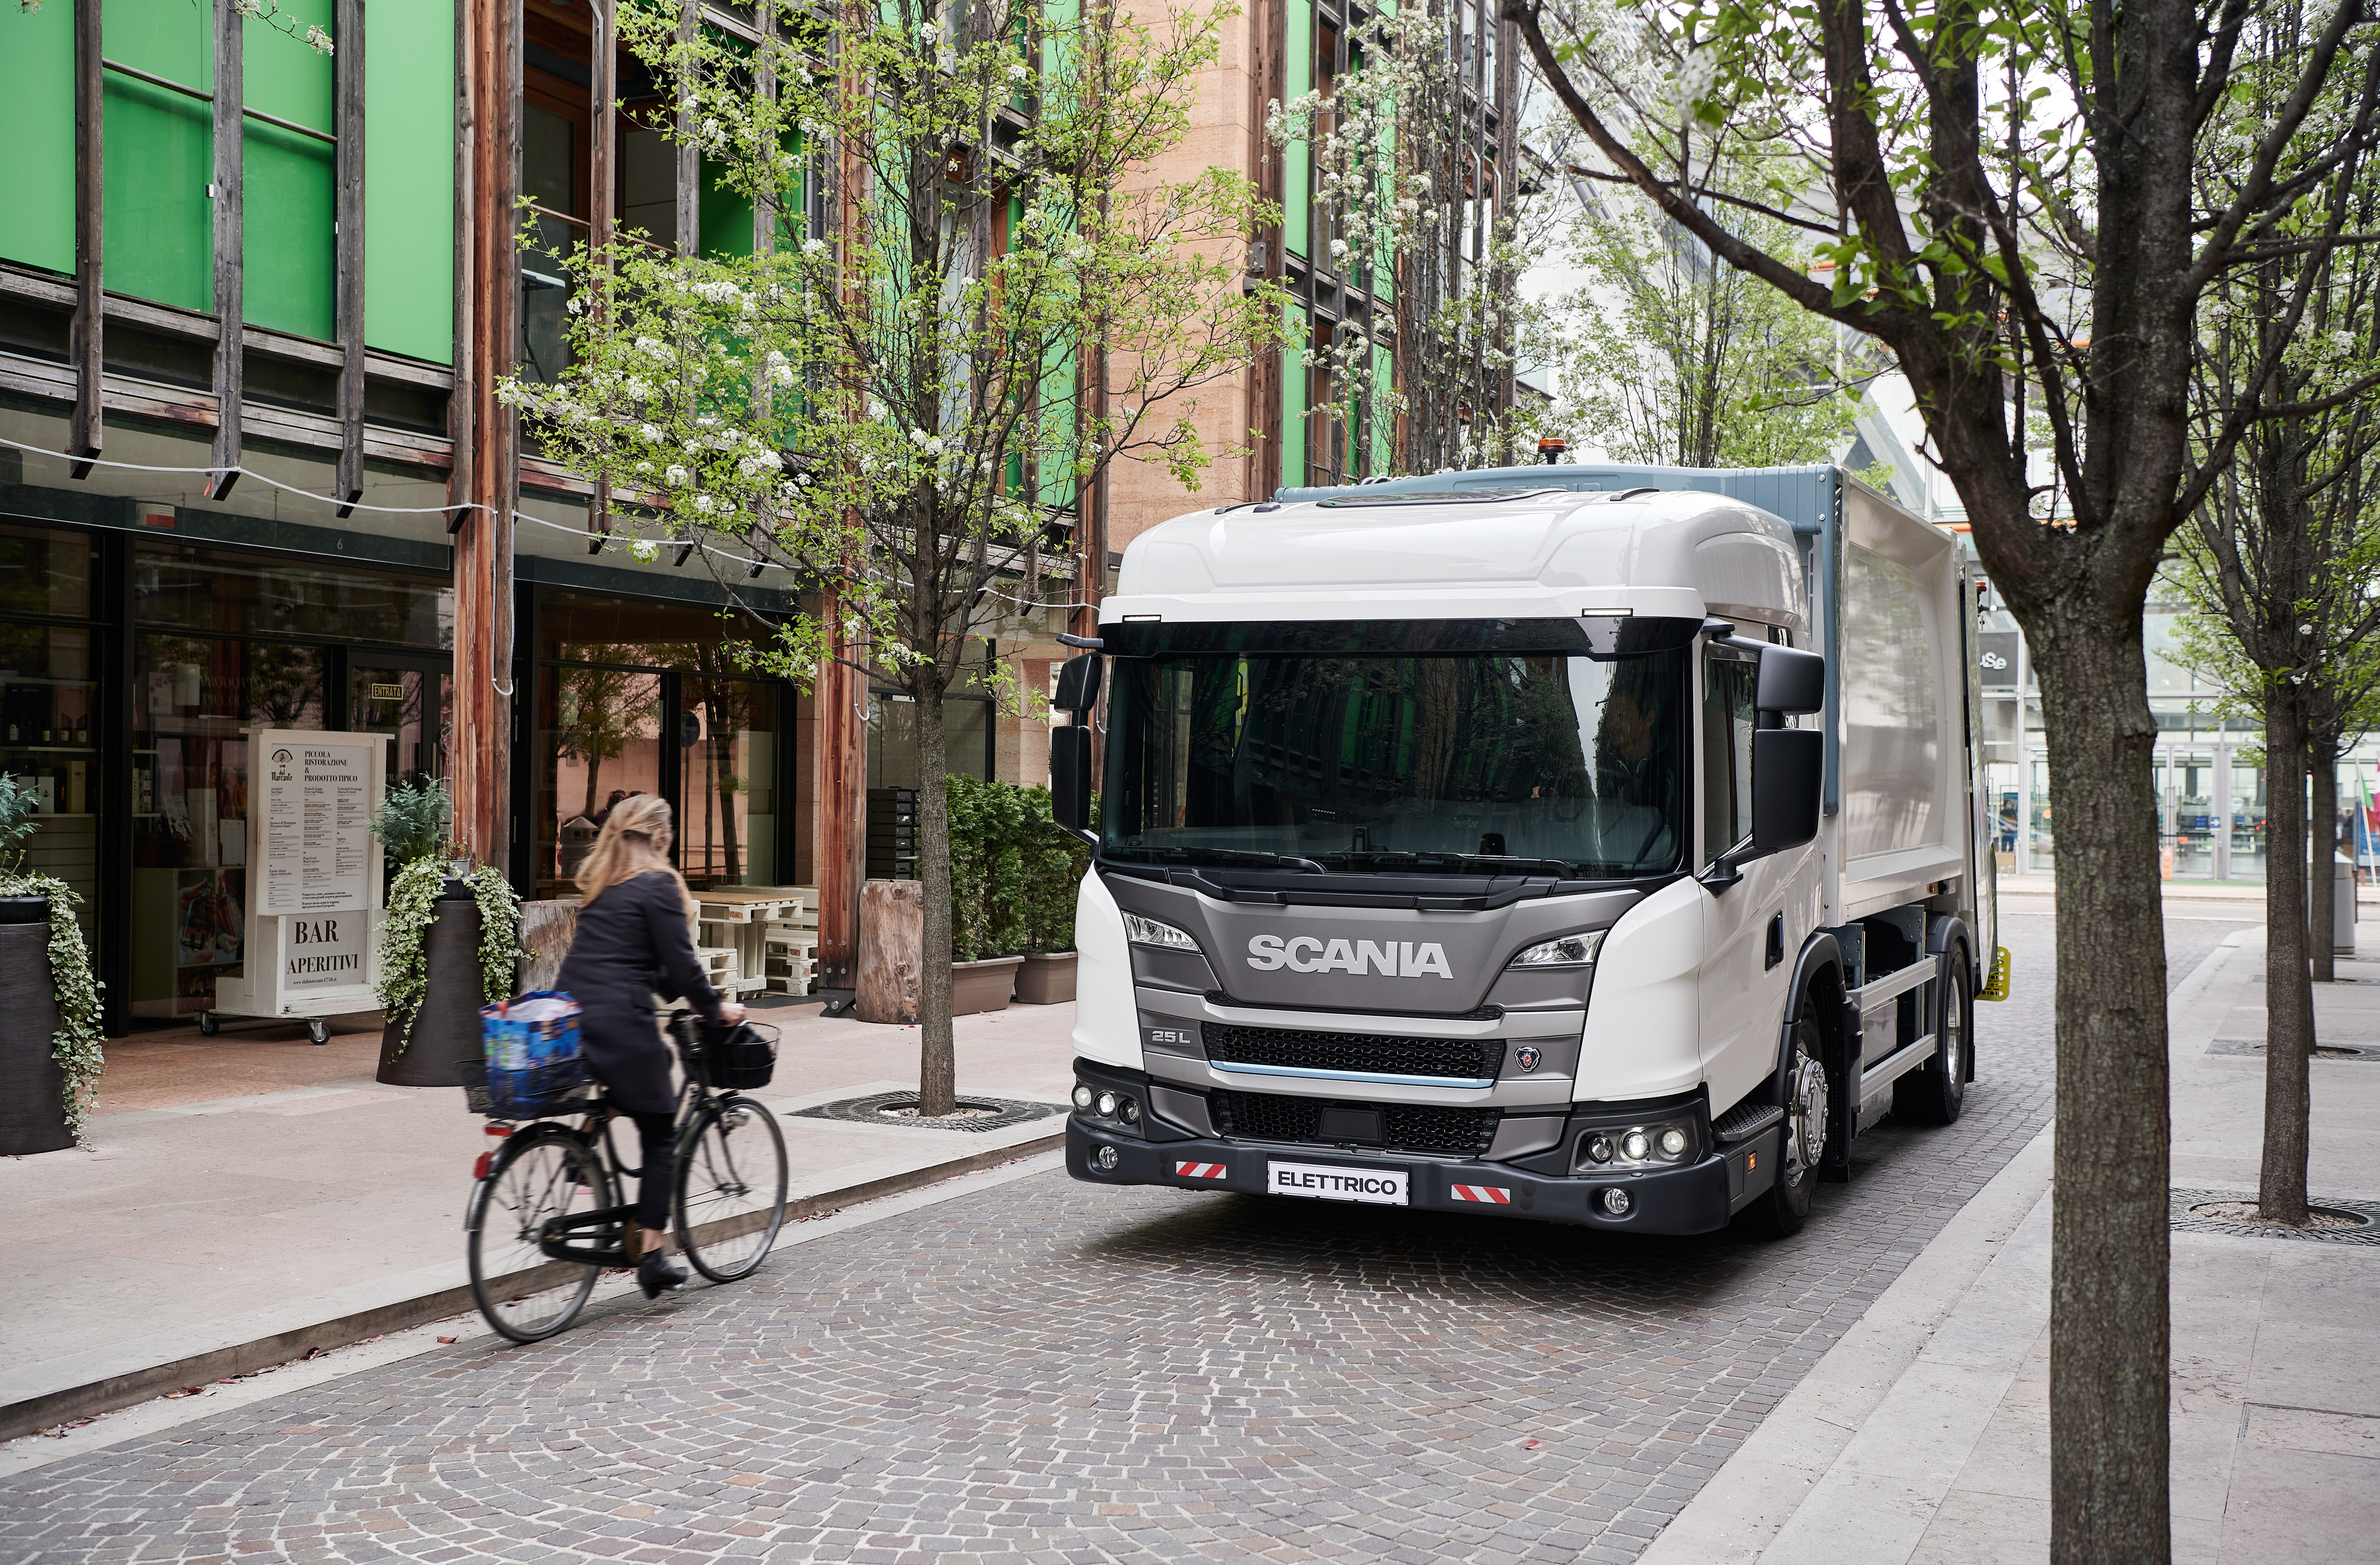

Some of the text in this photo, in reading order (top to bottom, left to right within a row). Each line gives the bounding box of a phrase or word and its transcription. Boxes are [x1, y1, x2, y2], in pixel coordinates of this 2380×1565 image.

[337, 538, 343, 550] 6
[374, 686, 401, 698] ENTRATA
[294, 920, 339, 944] BAR
[287, 954, 358, 974] APERITIVI
[1246, 934, 1454, 979] SCANIA
[1152, 1030, 1191, 1044] 25 L
[1278, 1171, 1397, 1195] ELETTRICO
